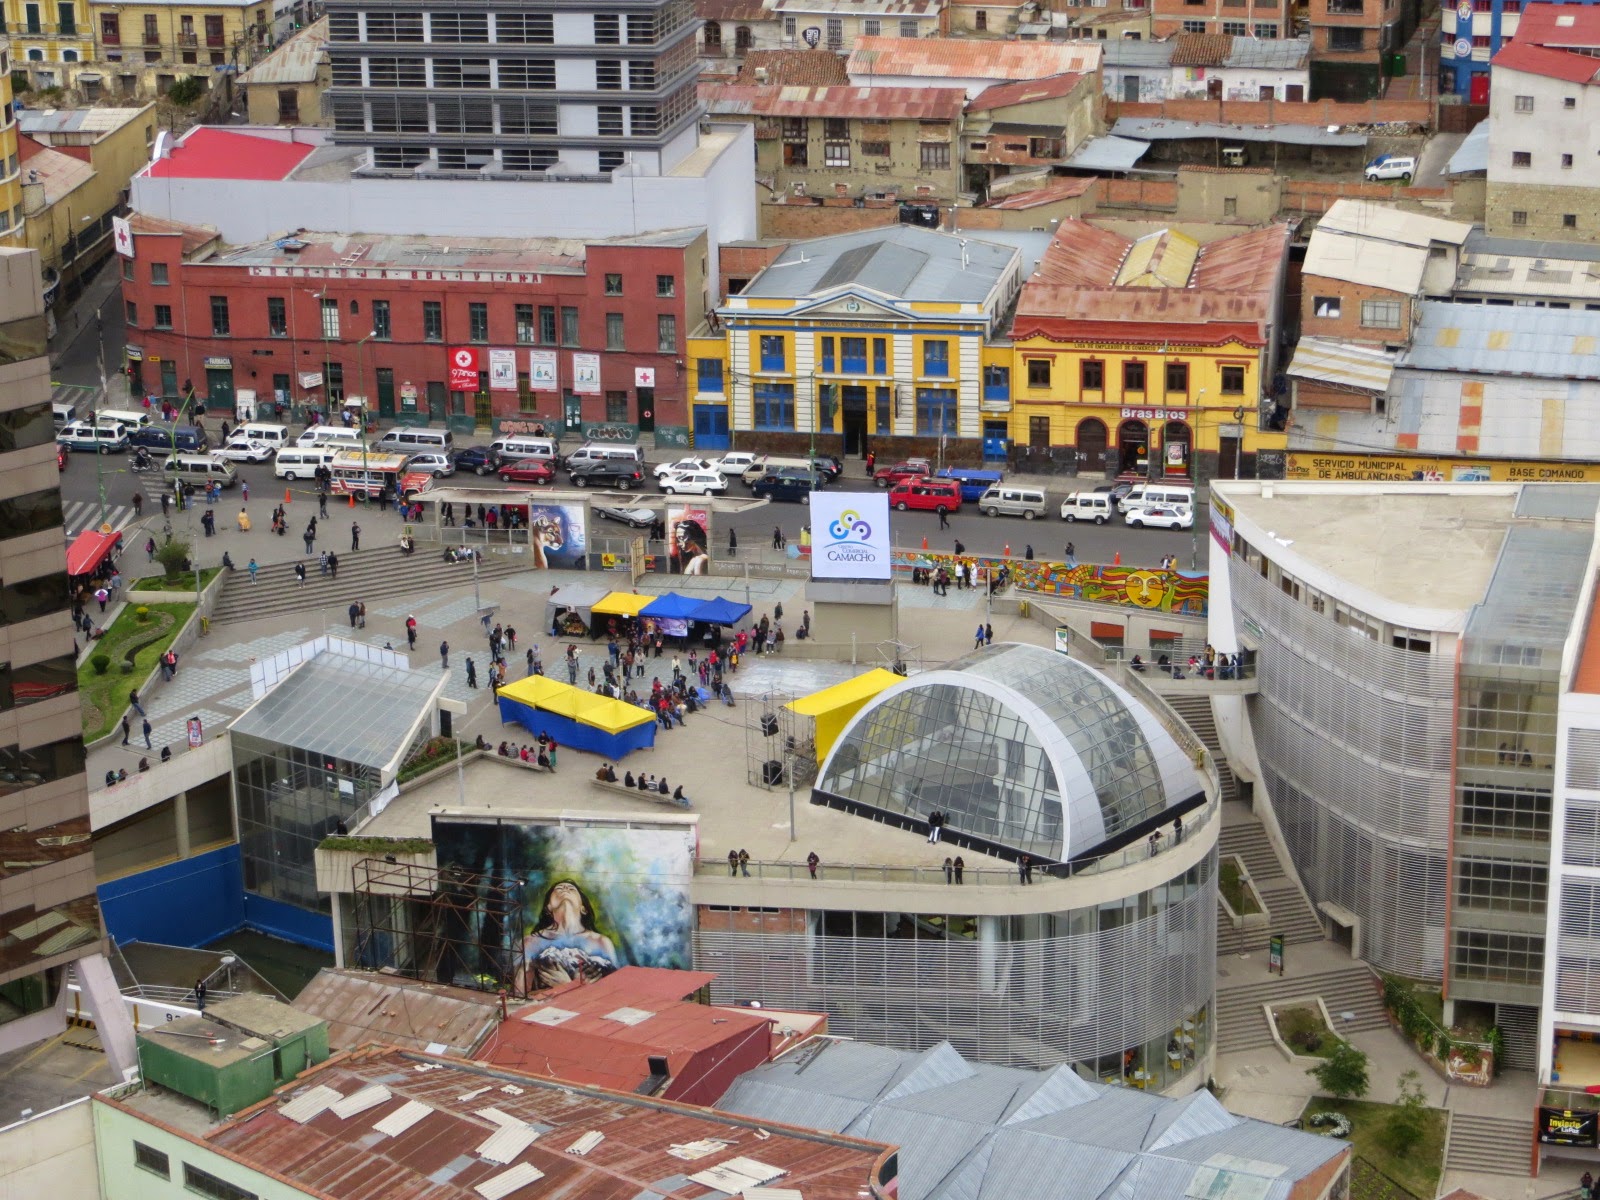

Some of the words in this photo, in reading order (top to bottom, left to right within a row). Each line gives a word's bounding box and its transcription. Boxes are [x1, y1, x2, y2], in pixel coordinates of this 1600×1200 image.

[411, 271, 539, 282] BOLIVIANA
[209, 357, 231, 365] FARMACIA
[1121, 408, 1152, 418] Bras
[1155, 408, 1186, 419] Bros
[1312, 459, 1354, 468] SERVICIO
[1358, 460, 1407, 470] MUNICIPAL
[1416, 464, 1439, 472] SEMA
[1318, 470, 1331, 479] DE
[1335, 471, 1400, 481] AMBULANCIAS
[1509, 468, 1534, 477] BASE
[1538, 469, 1584, 478] COMANDO
[827, 551, 876, 562] CAMACHO
[1550, 1119, 1581, 1129] Invierte
